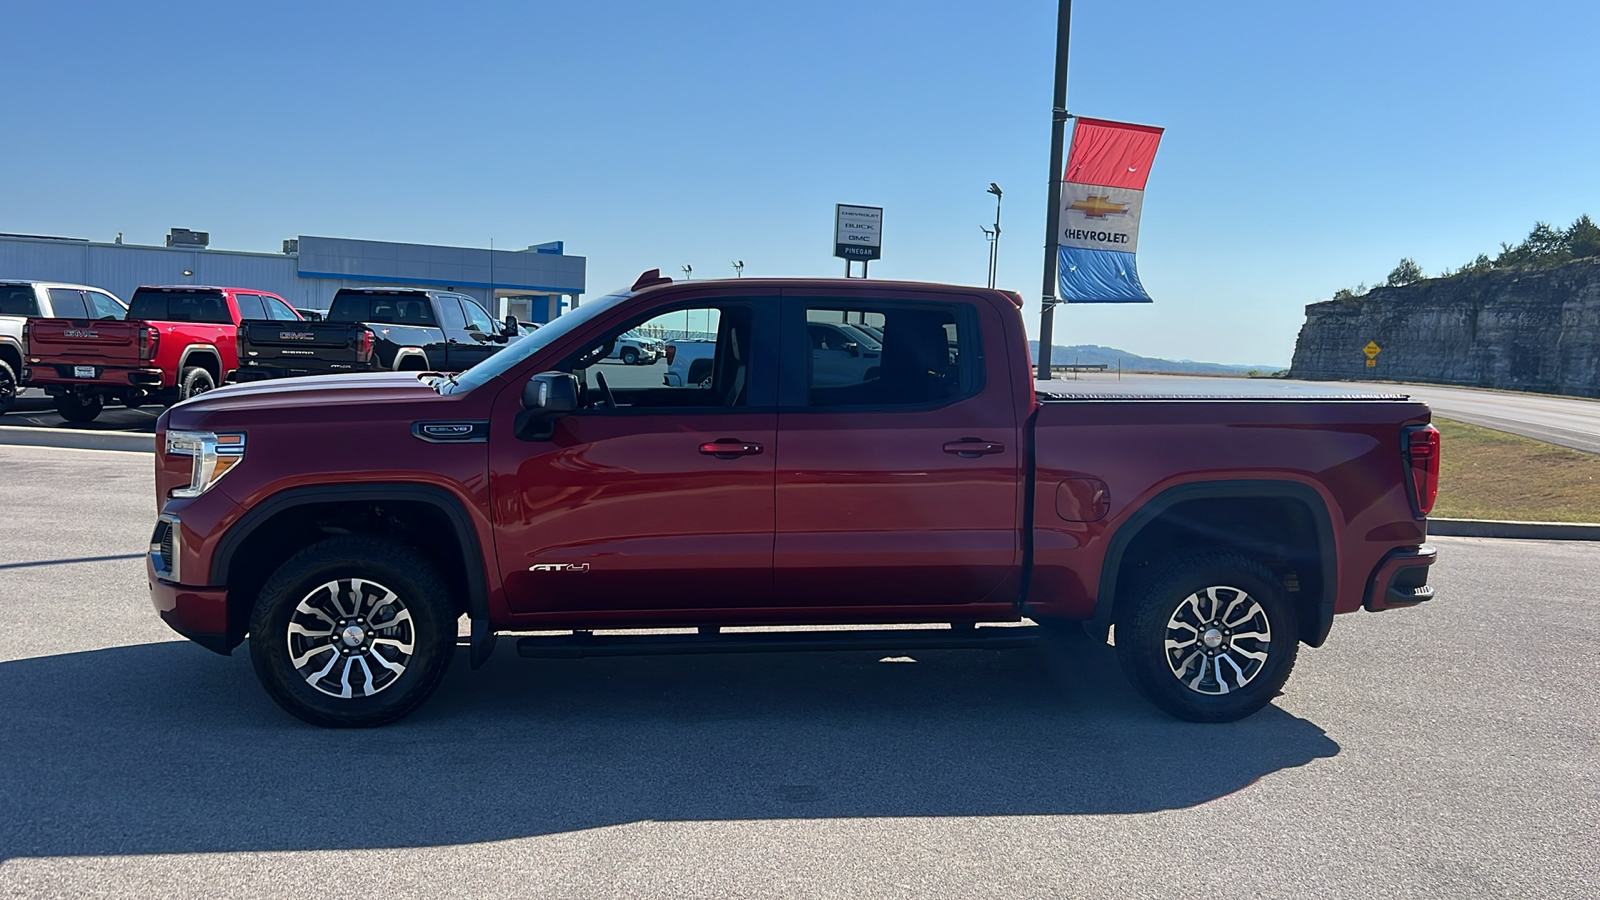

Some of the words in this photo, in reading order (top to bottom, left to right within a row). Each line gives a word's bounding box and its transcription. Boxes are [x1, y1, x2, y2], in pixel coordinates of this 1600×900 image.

[844, 247, 873, 255] PINEGAR
[63, 329, 99, 338] GMC
[279, 331, 315, 340] GMC
[528, 563, 590, 574] AT4
